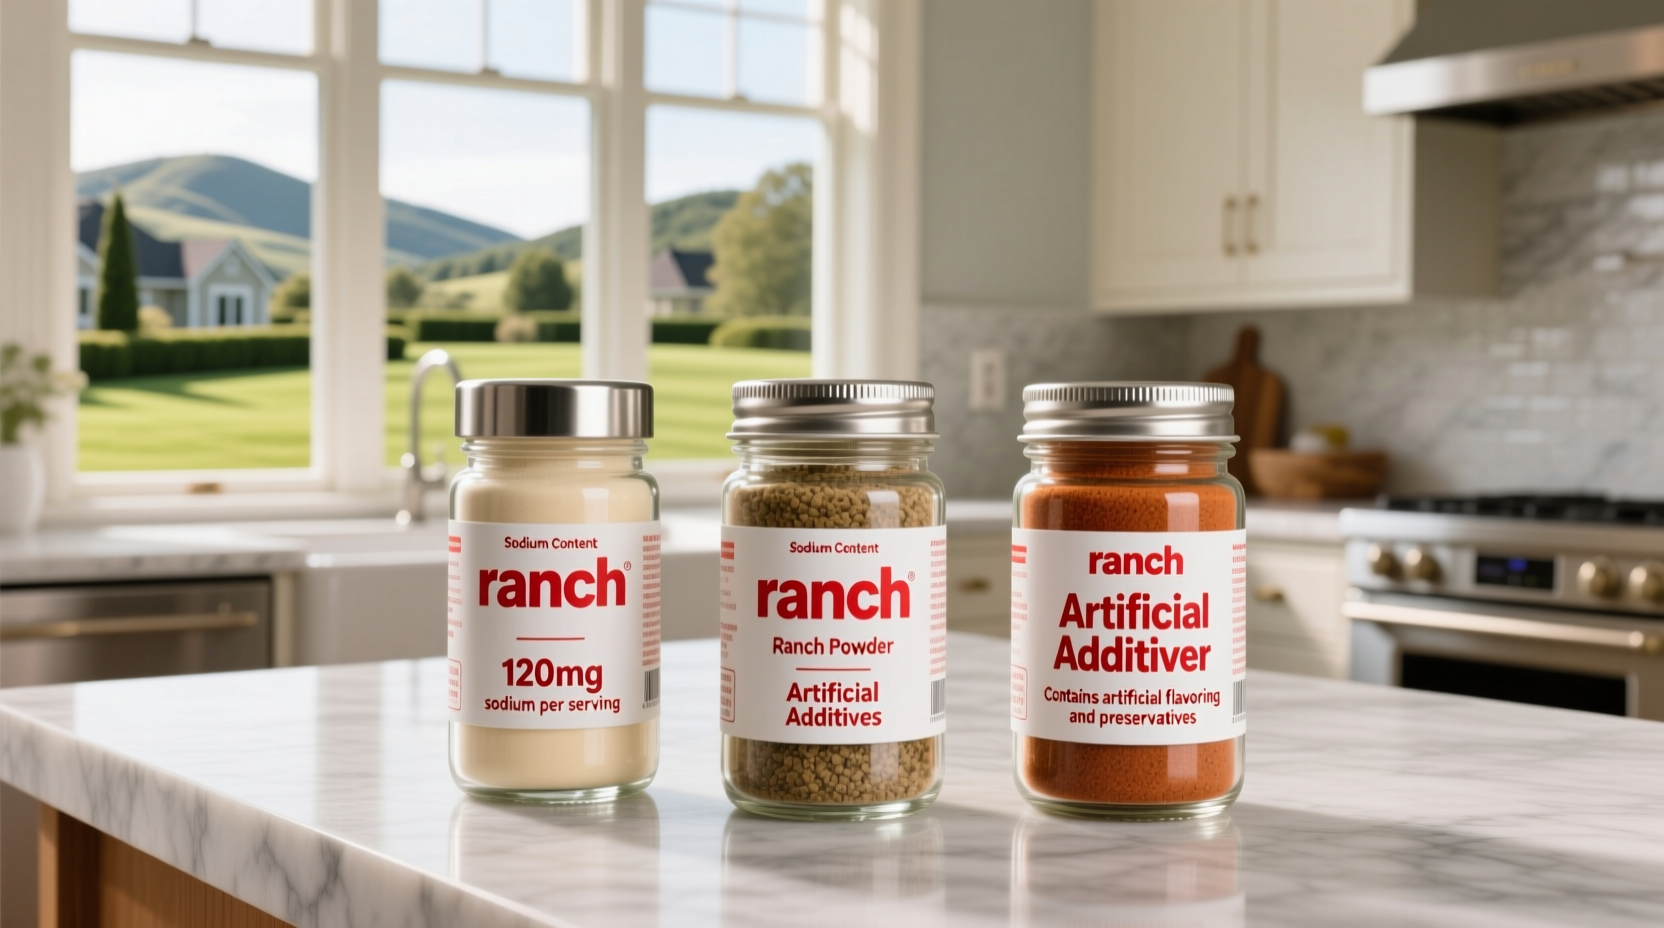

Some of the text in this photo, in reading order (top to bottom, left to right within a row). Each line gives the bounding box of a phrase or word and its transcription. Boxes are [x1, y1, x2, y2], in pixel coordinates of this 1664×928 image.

[504, 536, 598, 549] Sodium Content
[789, 541, 879, 554] Sodium Content
[1088, 545, 1184, 575] ranch
[1058, 592, 1209, 630] Artificial
[772, 637, 894, 655] Ranch Powder
[1053, 635, 1212, 673] Additiver
[501, 658, 603, 694] 120mg
[786, 681, 879, 703] Artificial
[1043, 687, 1100, 705] Contains
[1102, 689, 1162, 705] artificial
[1166, 688, 1221, 707] flavoring
[484, 696, 621, 716] sodium per serving
[785, 706, 882, 727] Additives
[1069, 709, 1197, 728] and preservatives
